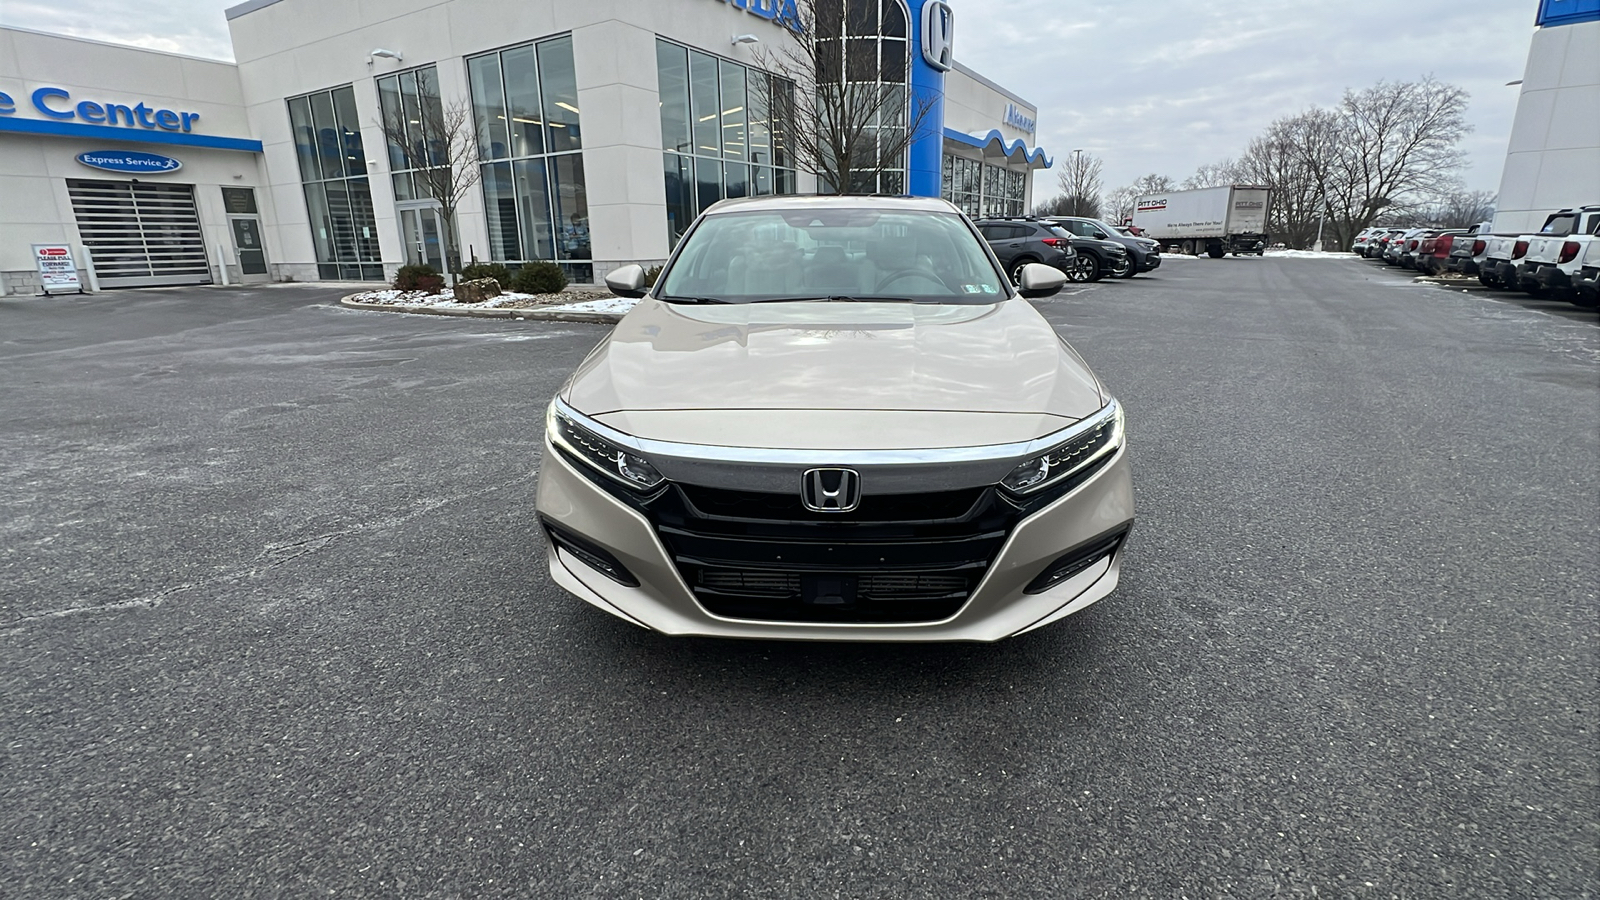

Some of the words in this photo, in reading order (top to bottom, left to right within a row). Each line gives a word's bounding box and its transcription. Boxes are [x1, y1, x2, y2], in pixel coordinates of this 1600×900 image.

[32, 87, 200, 133] Center
[83, 154, 124, 165] Express
[125, 157, 163, 168] Service
